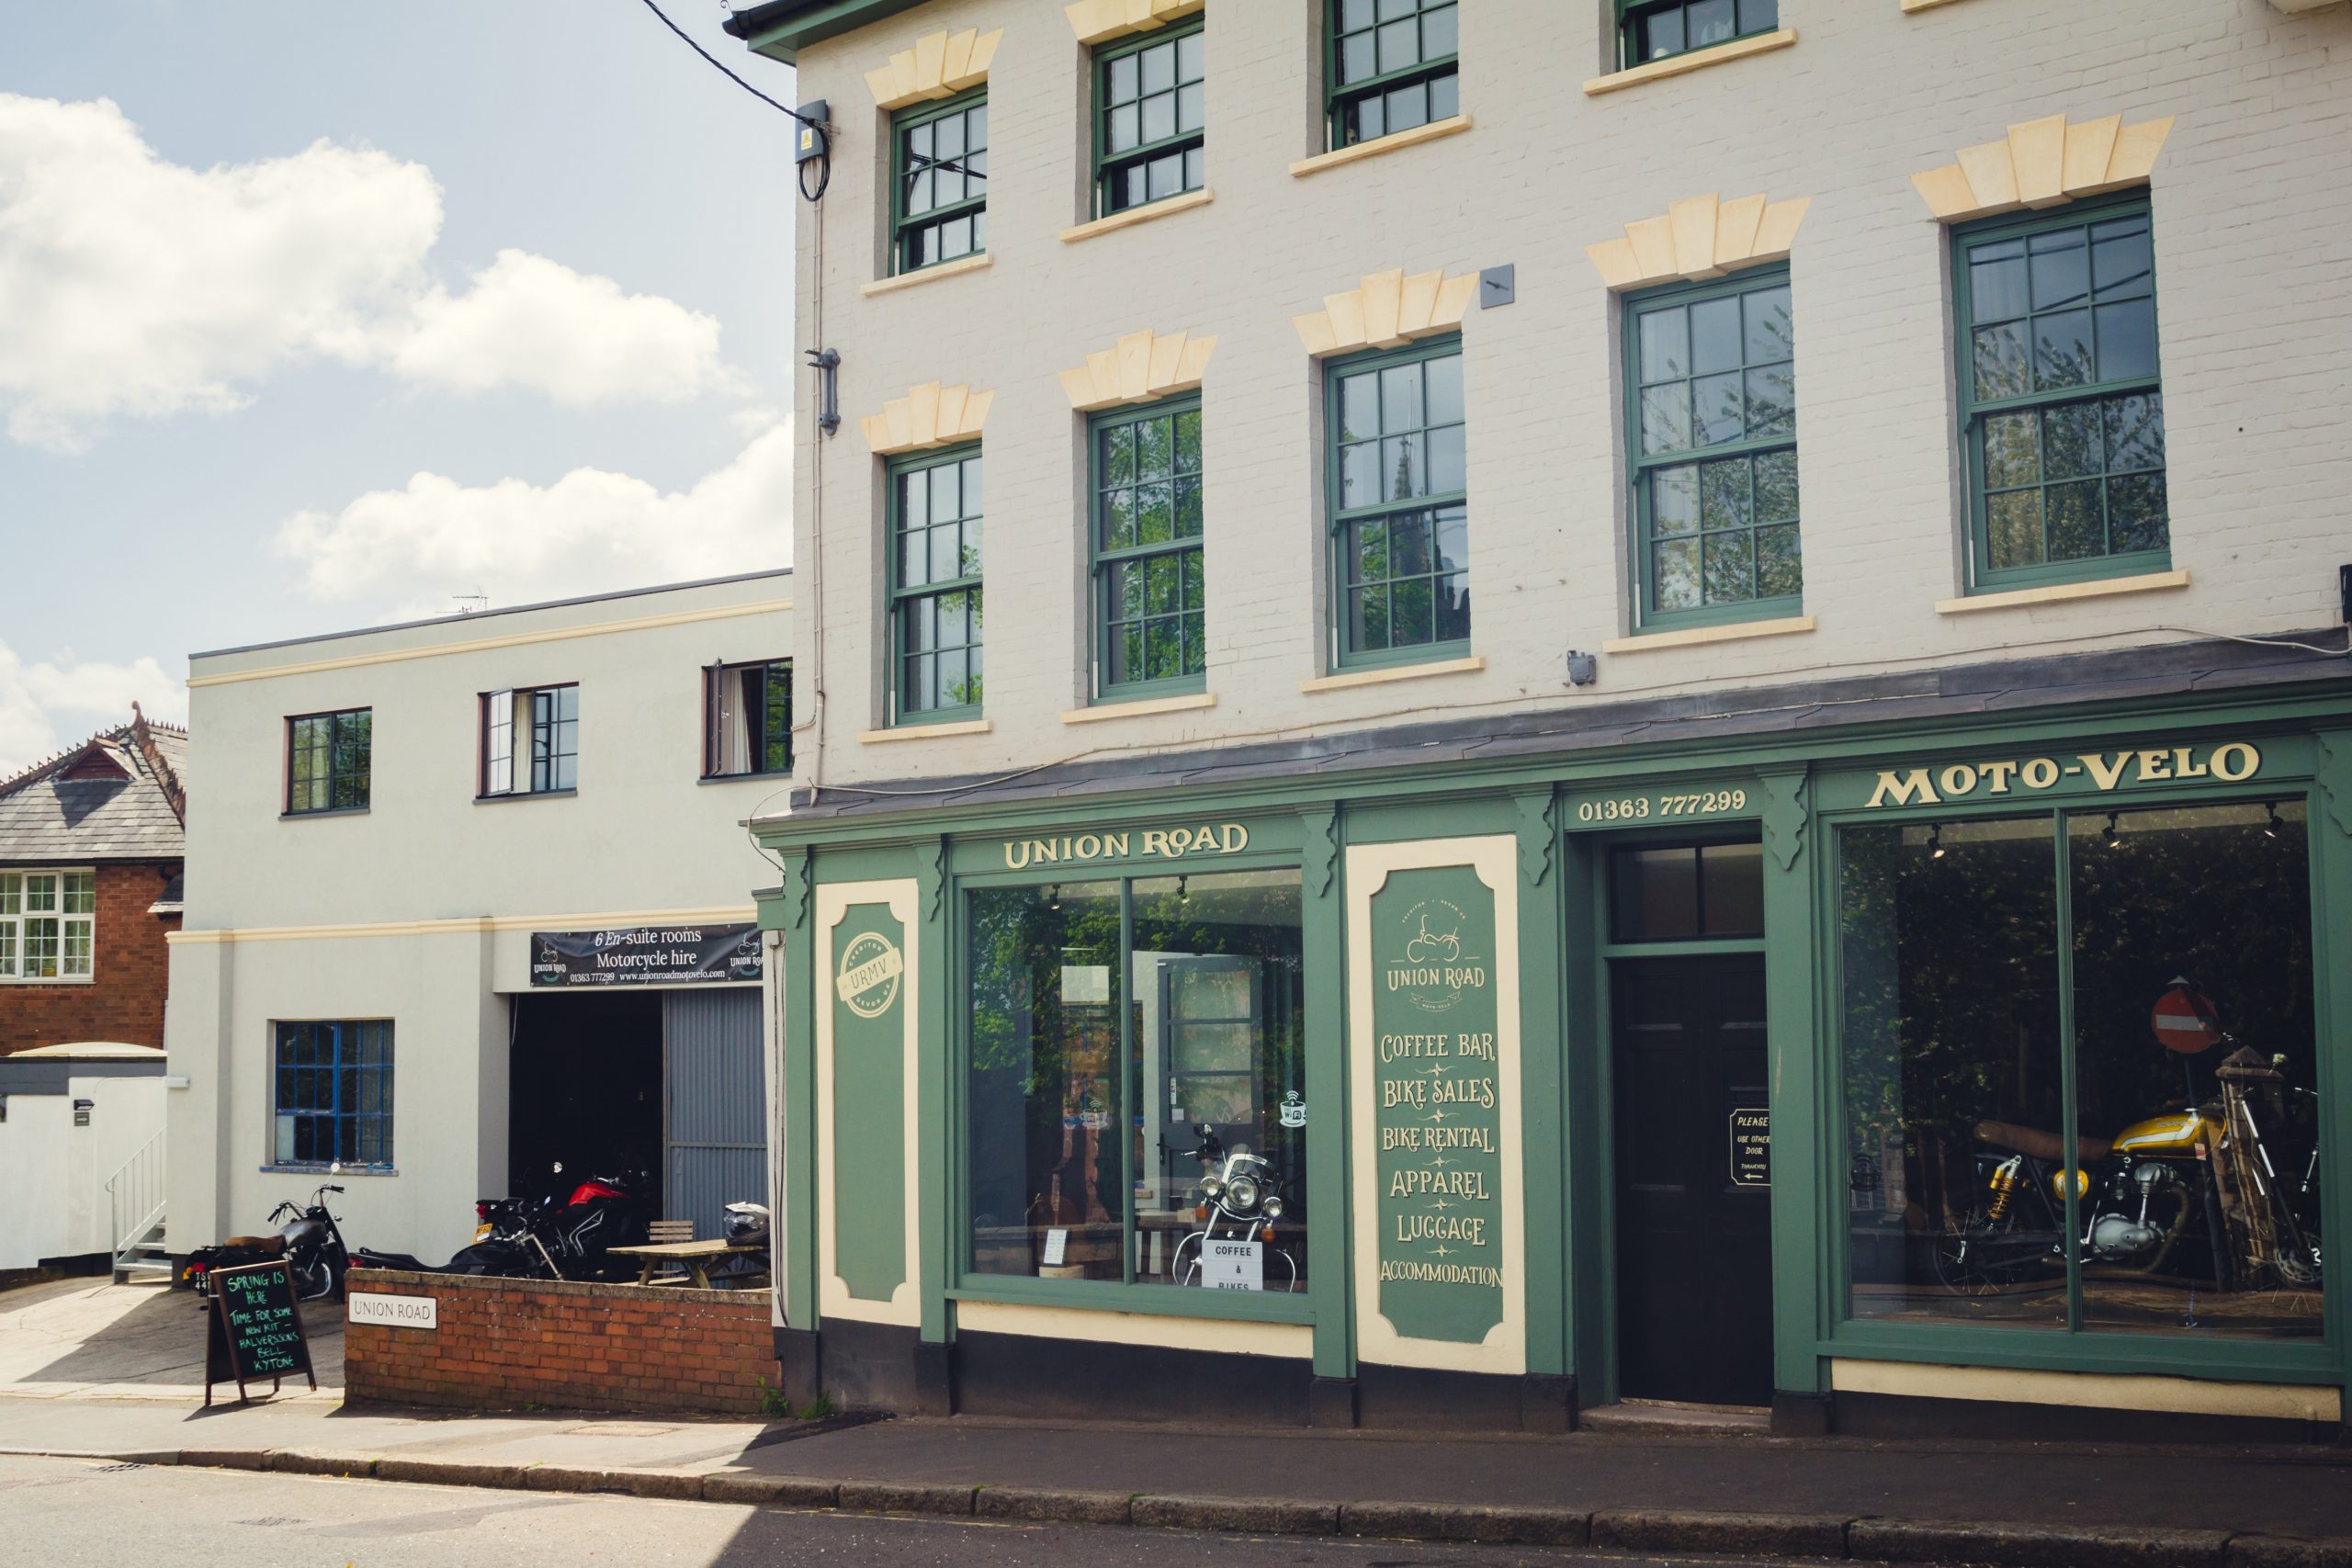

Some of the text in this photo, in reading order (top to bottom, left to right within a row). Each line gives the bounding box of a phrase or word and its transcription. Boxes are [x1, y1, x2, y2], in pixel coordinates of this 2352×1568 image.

[1863, 742, 2262, 808] MOTO-VELO
[1578, 789, 1747, 821] 01363 777299
[1003, 823, 1250, 869] UNION ROAD
[594, 929, 702, 947] 6 En-suite rooms
[534, 964, 553, 974] UNION
[596, 949, 697, 970] Motorcycle hire
[730, 956, 752, 967] UNION
[570, 969, 726, 983] 01363 777299 www.unionroadmotovelo.com
[851, 958, 888, 989] URMV
[1387, 967, 1486, 991] UNION ROAD
[1381, 1032, 1496, 1063] COFFEE BAR
[1384, 1077, 1496, 1110] BIKE SALES
[1737, 1116, 1770, 1127] PLEASE
[1383, 1127, 1495, 1154] BIKE RENTAL
[1737, 1135, 1749, 1144] USE
[1746, 1146, 1764, 1156] DOOR
[1390, 1170, 1490, 1201] APPAREL
[1397, 1214, 1487, 1246] LUGGAGE
[1216, 1246, 1251, 1257] COFFEE
[1236, 1265, 1241, 1274] &
[1380, 1259, 1504, 1288] ACCOMMODATION
[228, 1270, 285, 1292] SPRING IS
[245, 1291, 267, 1304] HERE
[230, 1306, 294, 1325] TIME FOR SOME
[355, 1300, 431, 1320] UNION ROAD
[263, 1322, 281, 1333] KIT
[256, 1347, 288, 1359] BELL
[254, 1355, 295, 1371] KYTONE
